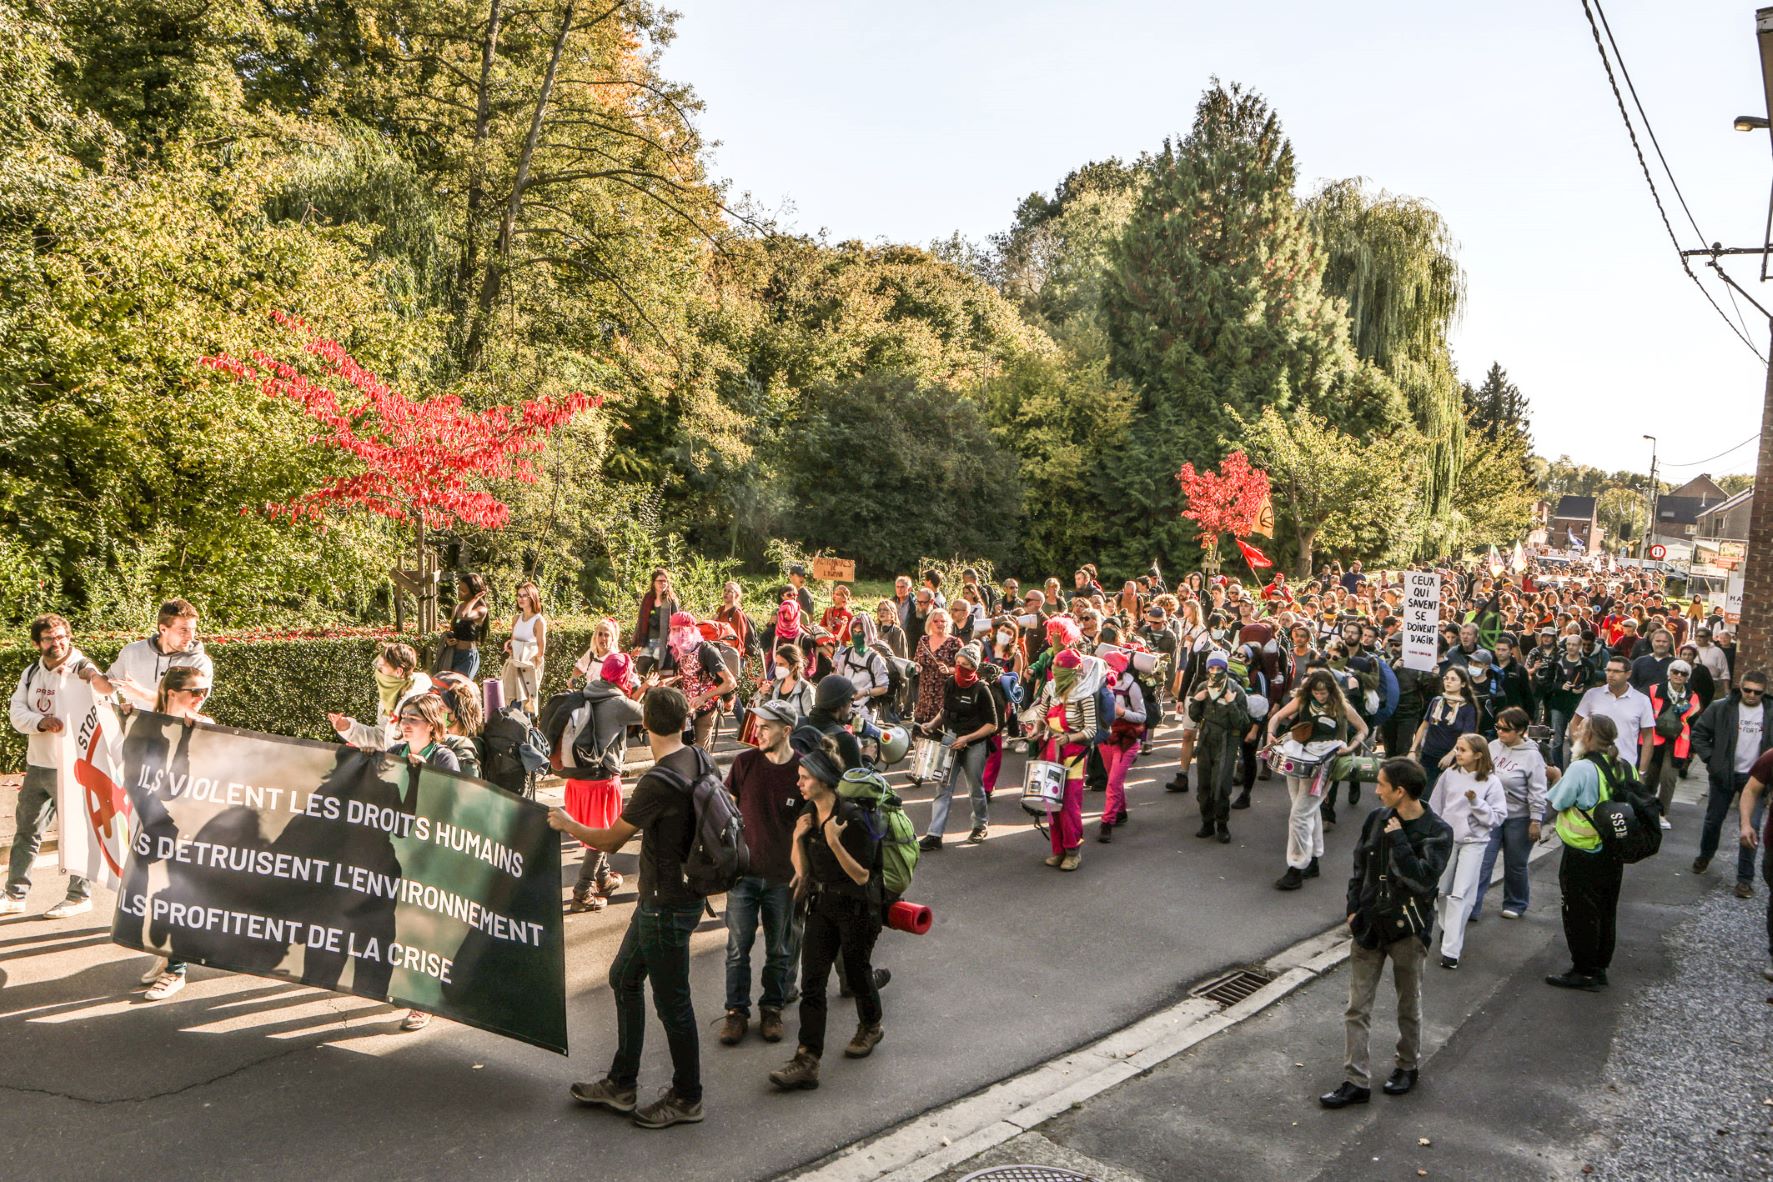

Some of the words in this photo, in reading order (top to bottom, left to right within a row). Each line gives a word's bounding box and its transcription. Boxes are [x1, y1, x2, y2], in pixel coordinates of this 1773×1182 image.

[1412, 575, 1435, 587] CEUX
[1408, 599, 1438, 610] SAVENT
[1415, 611, 1426, 621] SE
[78, 705, 100, 750] STOP
[137, 763, 164, 795] ILS
[169, 772, 283, 810] VIOLENT
[289, 790, 341, 820] LES
[346, 799, 430, 841] DROITS
[435, 821, 524, 878] HUMAINS
[1610, 812, 1628, 839] RESS
[156, 834, 330, 884] DÉTRUISENT
[334, 863, 543, 947] L'ENVIRONNEMENT
[152, 899, 303, 944] PROFITENT
[307, 924, 343, 953] DE
[347, 932, 381, 962] LA
[387, 942, 454, 984] CRISE
